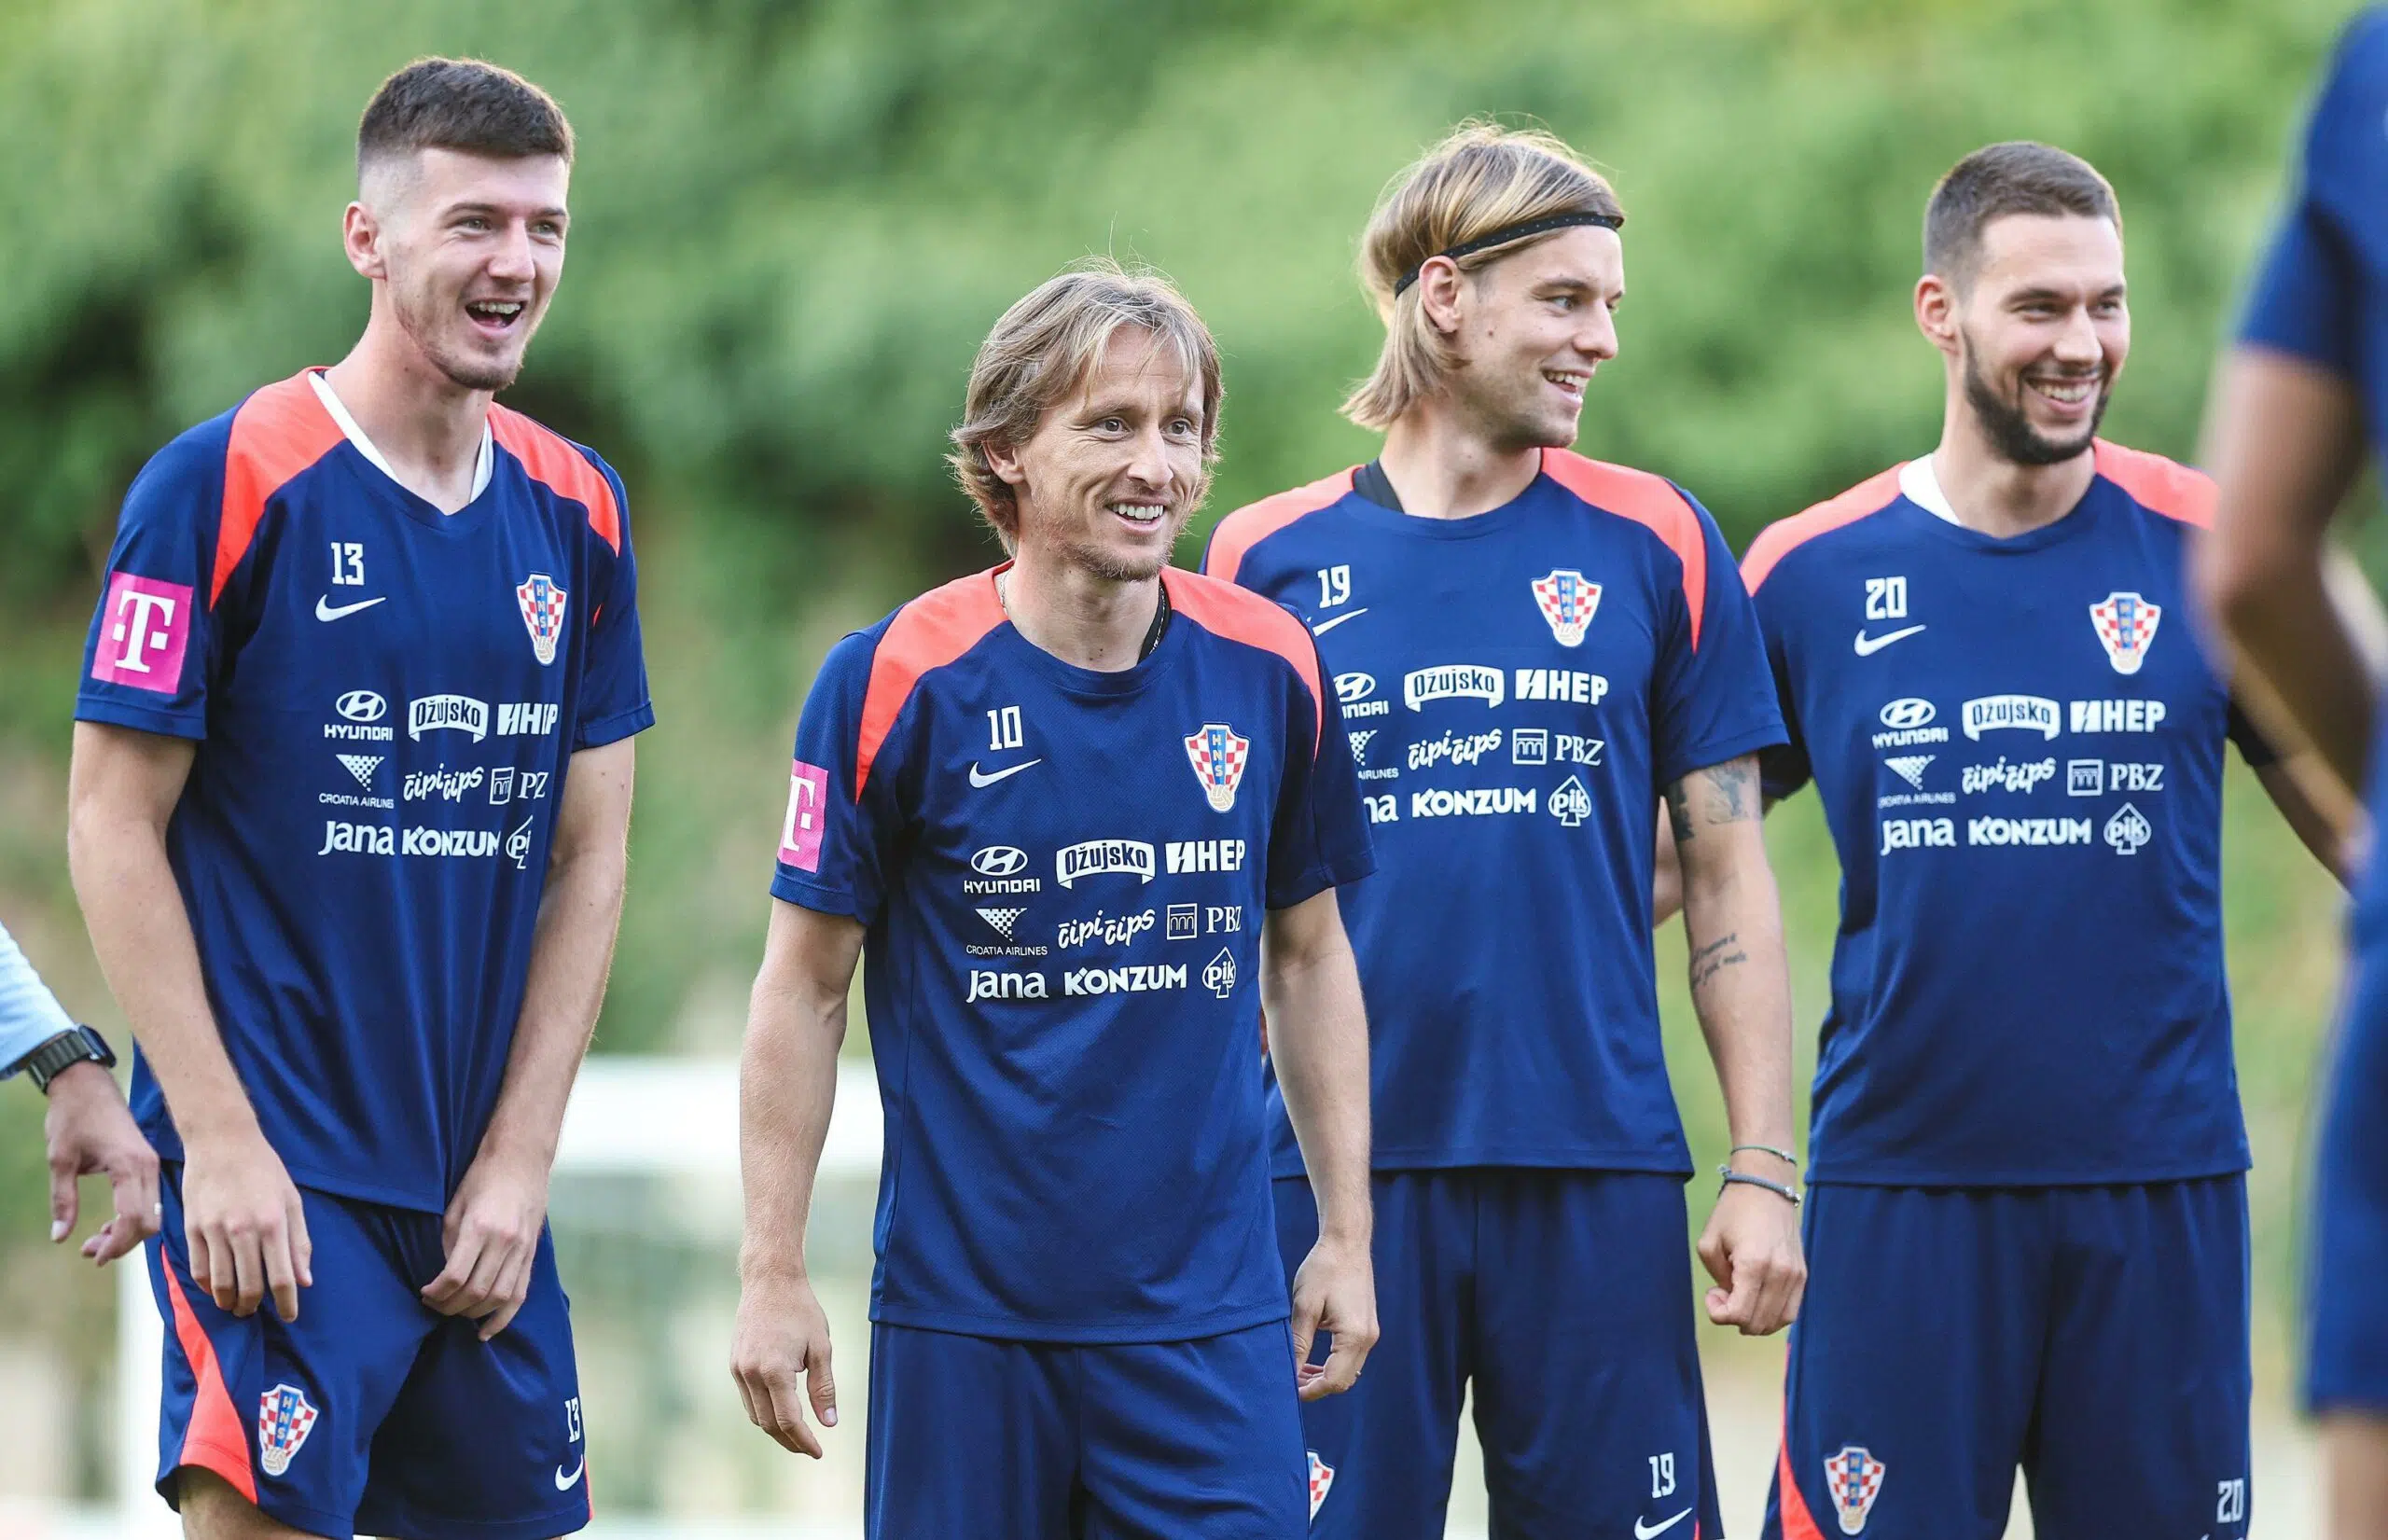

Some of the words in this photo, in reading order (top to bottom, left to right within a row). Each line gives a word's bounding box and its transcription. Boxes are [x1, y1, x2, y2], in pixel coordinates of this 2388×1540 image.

[331, 543, 364, 585] 13
[1318, 565, 1350, 607] 19
[1866, 576, 1907, 619] 20
[1412, 666, 1495, 699] Ožujsko
[1547, 670, 1608, 704] HEP
[415, 699, 480, 728] Ožujsko
[987, 706, 1022, 750] 10
[2103, 700, 2165, 732] HEP
[325, 725, 393, 741] HYUNDAI
[1872, 727, 1949, 748] HYUNDAI
[1554, 735, 1604, 765] PBZ
[2111, 764, 2163, 790] PBZ
[319, 793, 358, 805] CROATIA
[1412, 788, 1535, 817] KONZUM
[1558, 787, 1587, 817] pik
[318, 821, 395, 855] Jana
[1968, 816, 2091, 845] KONZUM
[2113, 814, 2147, 843] pik
[1064, 841, 1148, 875] Ožujsko
[1198, 839, 1245, 871] HEP
[965, 879, 1040, 894] HYUNDAI
[1205, 906, 1242, 933] PBZ
[966, 945, 1003, 954] CROATIA
[1006, 946, 1048, 955] AIRLINES
[966, 970, 1048, 1003] Jana
[1064, 964, 1187, 995] KONZUM
[1208, 960, 1235, 989] pik
[564, 1396, 581, 1443] 13
[1649, 1453, 1675, 1498] 19
[2218, 1479, 2243, 1522] 20
